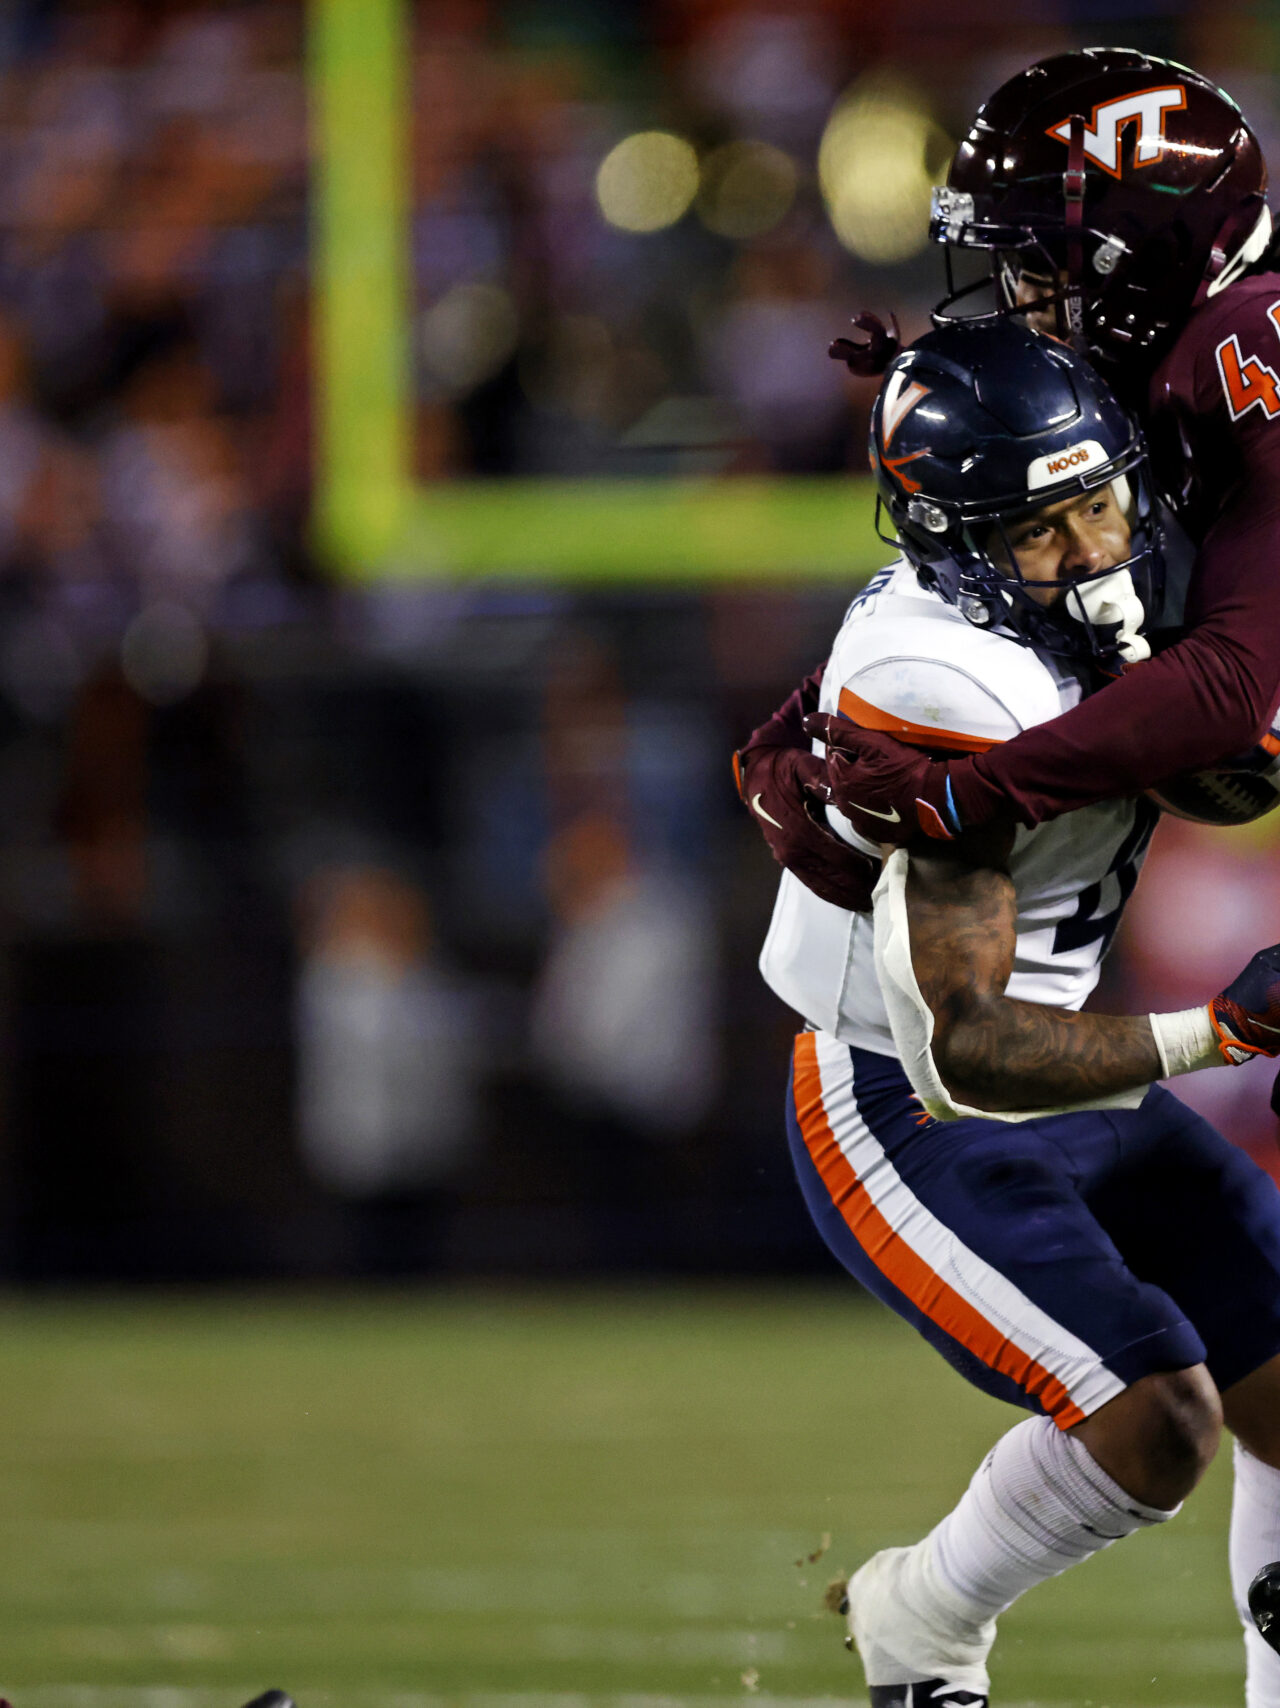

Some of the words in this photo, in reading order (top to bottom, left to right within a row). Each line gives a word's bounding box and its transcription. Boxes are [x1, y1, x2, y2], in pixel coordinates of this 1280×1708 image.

[1044, 84, 1188, 180] VT
[1068, 285, 1084, 335] OKIE
[1047, 448, 1089, 475] HOOS
